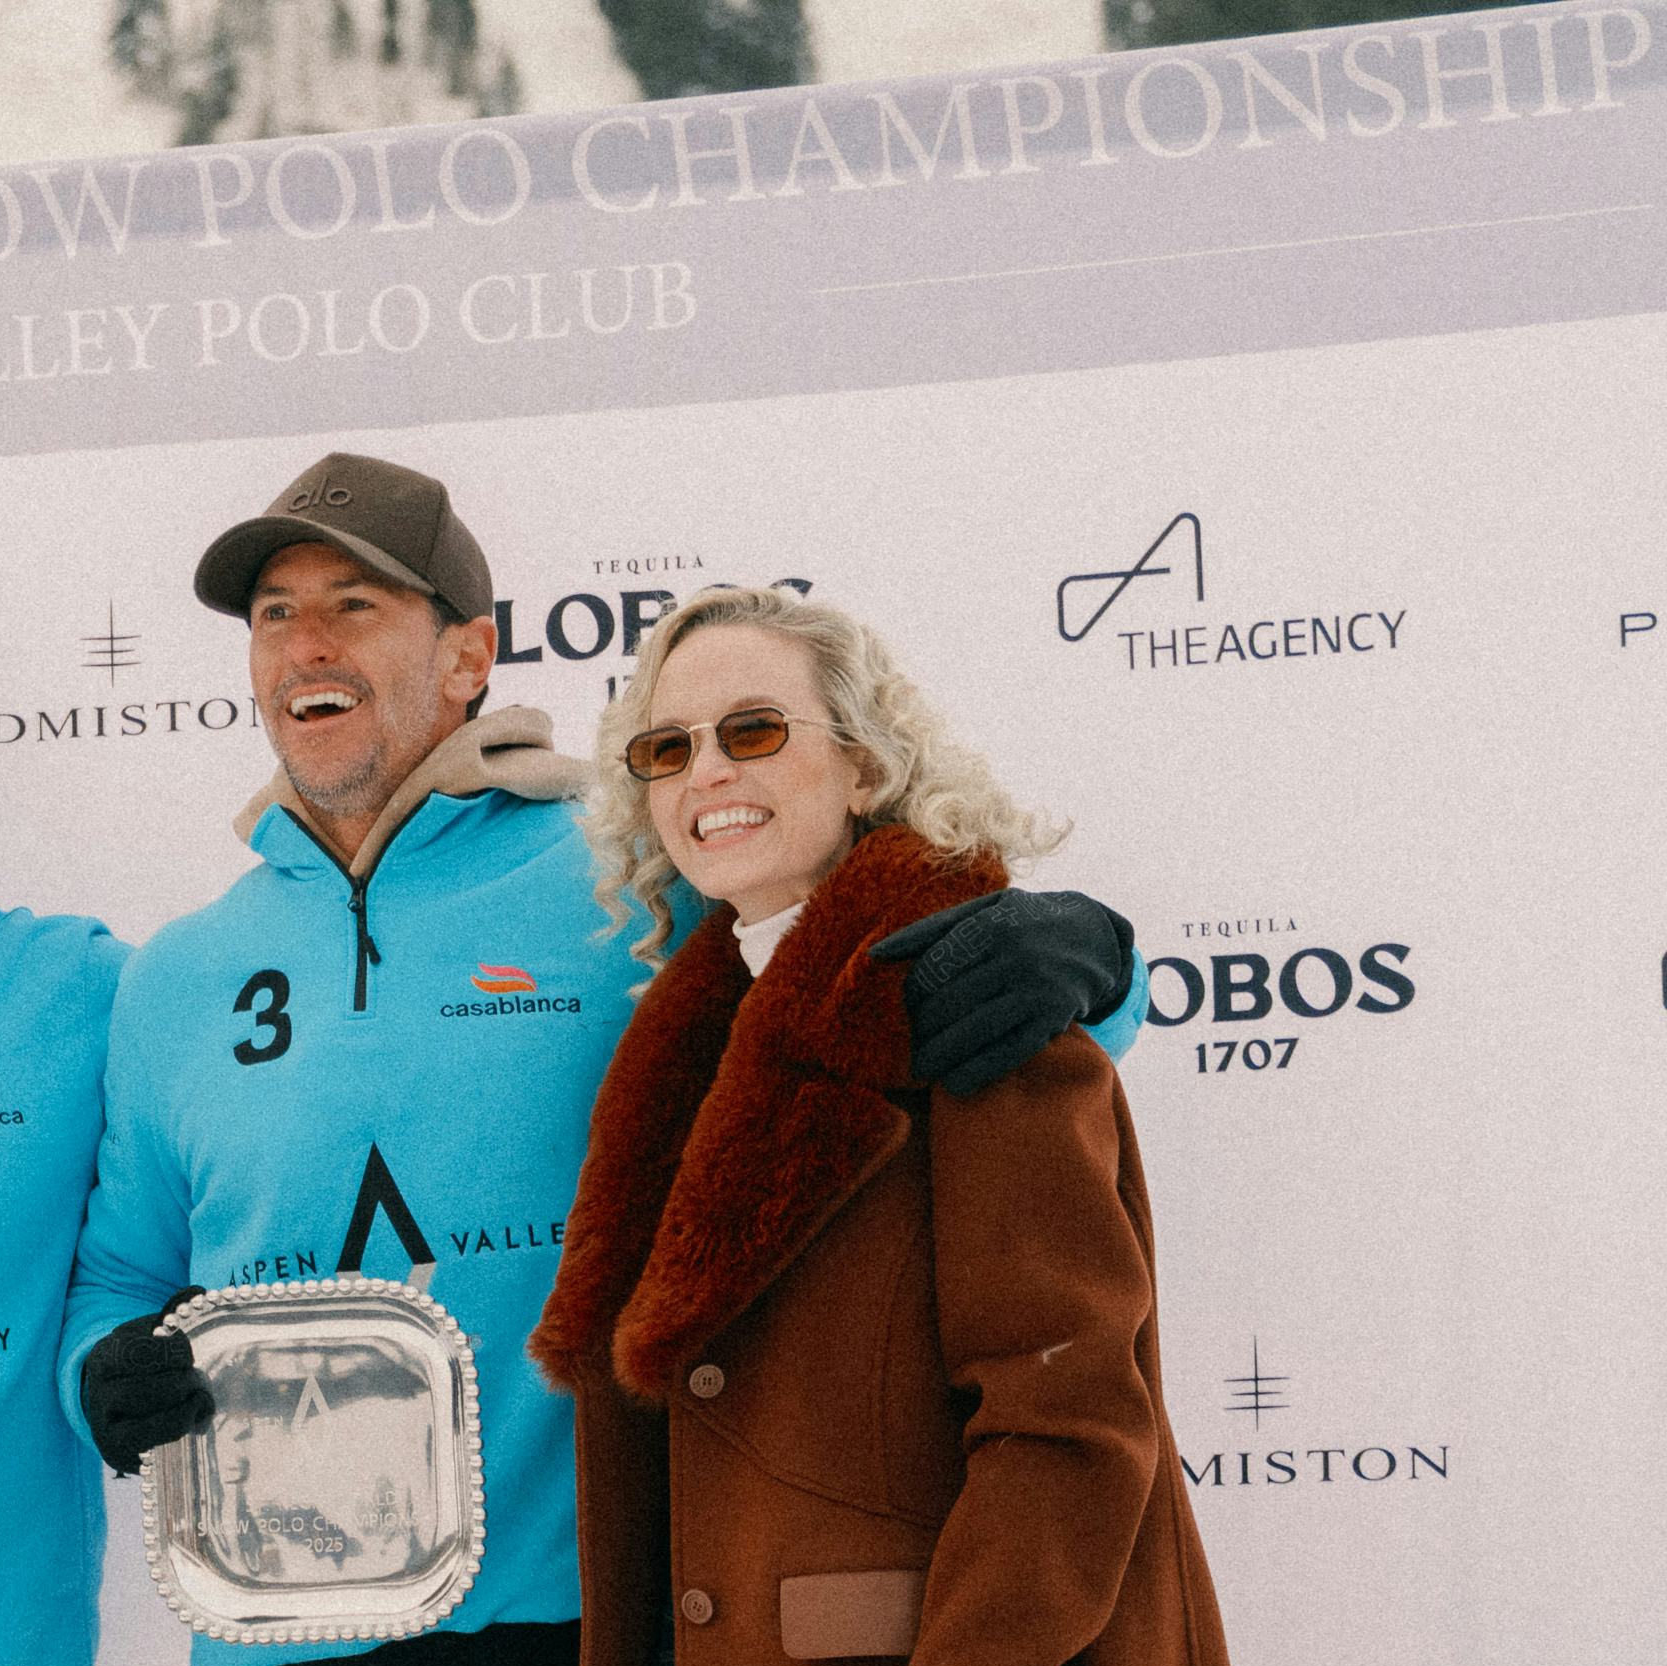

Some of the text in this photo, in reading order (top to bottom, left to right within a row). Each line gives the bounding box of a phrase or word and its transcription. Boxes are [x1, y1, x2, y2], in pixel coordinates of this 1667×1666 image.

[178, 127, 535, 247] POLO
[571, 6, 1651, 215] CHAMPIONSHIP
[198, 284, 430, 366] POLO
[458, 260, 699, 345] CLUB
[287, 479, 353, 513] alo
[593, 555, 703, 575] TEQUILA
[1182, 918, 1297, 938] TEQUILA
[1146, 942, 1416, 1028] OBOS
[233, 969, 292, 1065] 3
[440, 994, 581, 1018] casablanca
[1196, 1038, 1299, 1073] 1707
[450, 1222, 565, 1255] VALLE
[1178, 1445, 1451, 1488] MISTON
[259, 1517, 305, 1533] POLO
